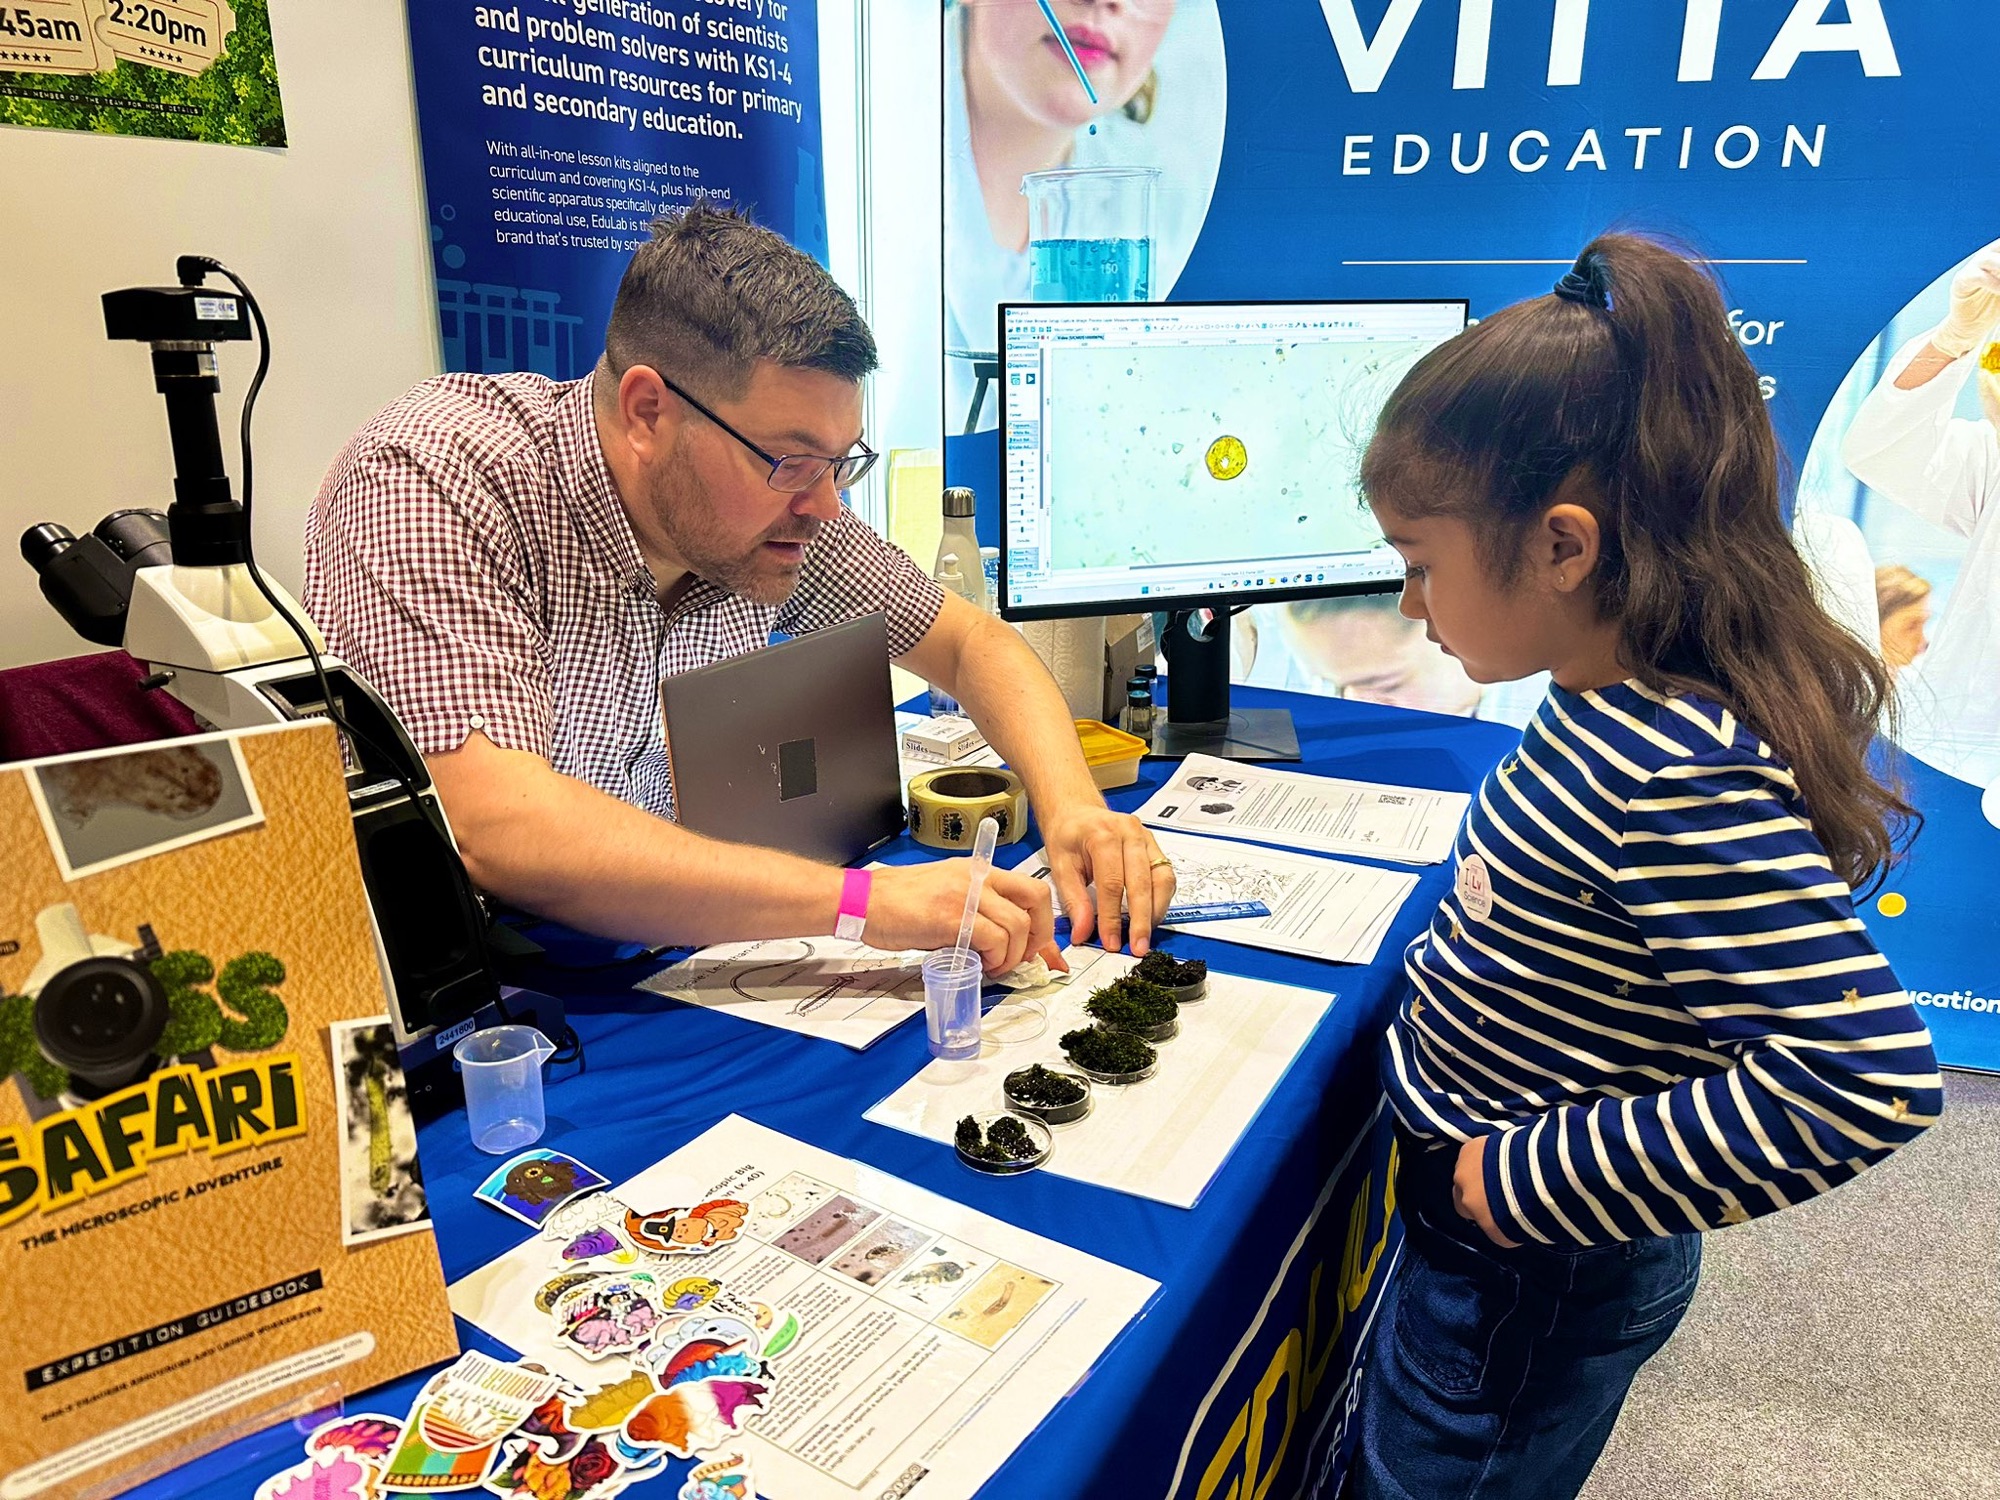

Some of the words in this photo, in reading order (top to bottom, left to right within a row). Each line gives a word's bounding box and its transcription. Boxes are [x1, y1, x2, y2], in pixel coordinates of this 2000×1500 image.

[109, 0, 207, 47] 2:20pm
[681, 12, 700, 35] of
[706, 17, 789, 53] scientists
[475, 6, 520, 33] and
[526, 15, 616, 52] problem
[621, 34, 690, 67] solvers
[694, 48, 739, 74] with
[744, 53, 793, 85] KS1-4
[478, 46, 604, 85] curriculum
[609, 67, 703, 101] resources
[707, 81, 737, 105] for
[742, 88, 802, 124] primary
[482, 83, 527, 109] and
[533, 91, 637, 131] secondary
[642, 107, 743, 140] education.
[486, 139, 518, 157] With
[521, 144, 575, 163] all-in-one
[578, 150, 612, 168] lesson
[614, 155, 631, 171] kits
[633, 158, 668, 176] aligned
[670, 164, 680, 176] to
[683, 165, 699, 178] the
[1342, 124, 1827, 176] EDUCATION
[490, 165, 556, 182] curriculum
[559, 171, 580, 185] and
[583, 175, 626, 193] covering
[628, 178, 659, 195] KS1-4,
[661, 182, 683, 197] plus
[685, 184, 730, 199] high-end
[492, 186, 546, 203] scientific
[548, 193, 604, 208] apparatus
[605, 197, 656, 216] specifically
[494, 208, 564, 225] educational
[566, 215, 589, 229] use,
[591, 214, 628, 231] EduLab
[629, 218, 637, 231] is
[496, 229, 534, 244] brand
[536, 231, 568, 247] that's
[570, 235, 609, 249] trusted
[611, 236, 622, 253] by
[906, 742, 928, 753] Slides
[957, 741, 975, 753] Slides
[439, 1020, 474, 1045] 2441800
[21, 1229, 57, 1251] THE
[61, 1190, 180, 1240] MICROSCOPIC
[185, 1156, 283, 1199] ADVENTURE
[41, 1322, 184, 1383] EXPEDITION
[196, 1277, 310, 1326] GUIDEBOOK
